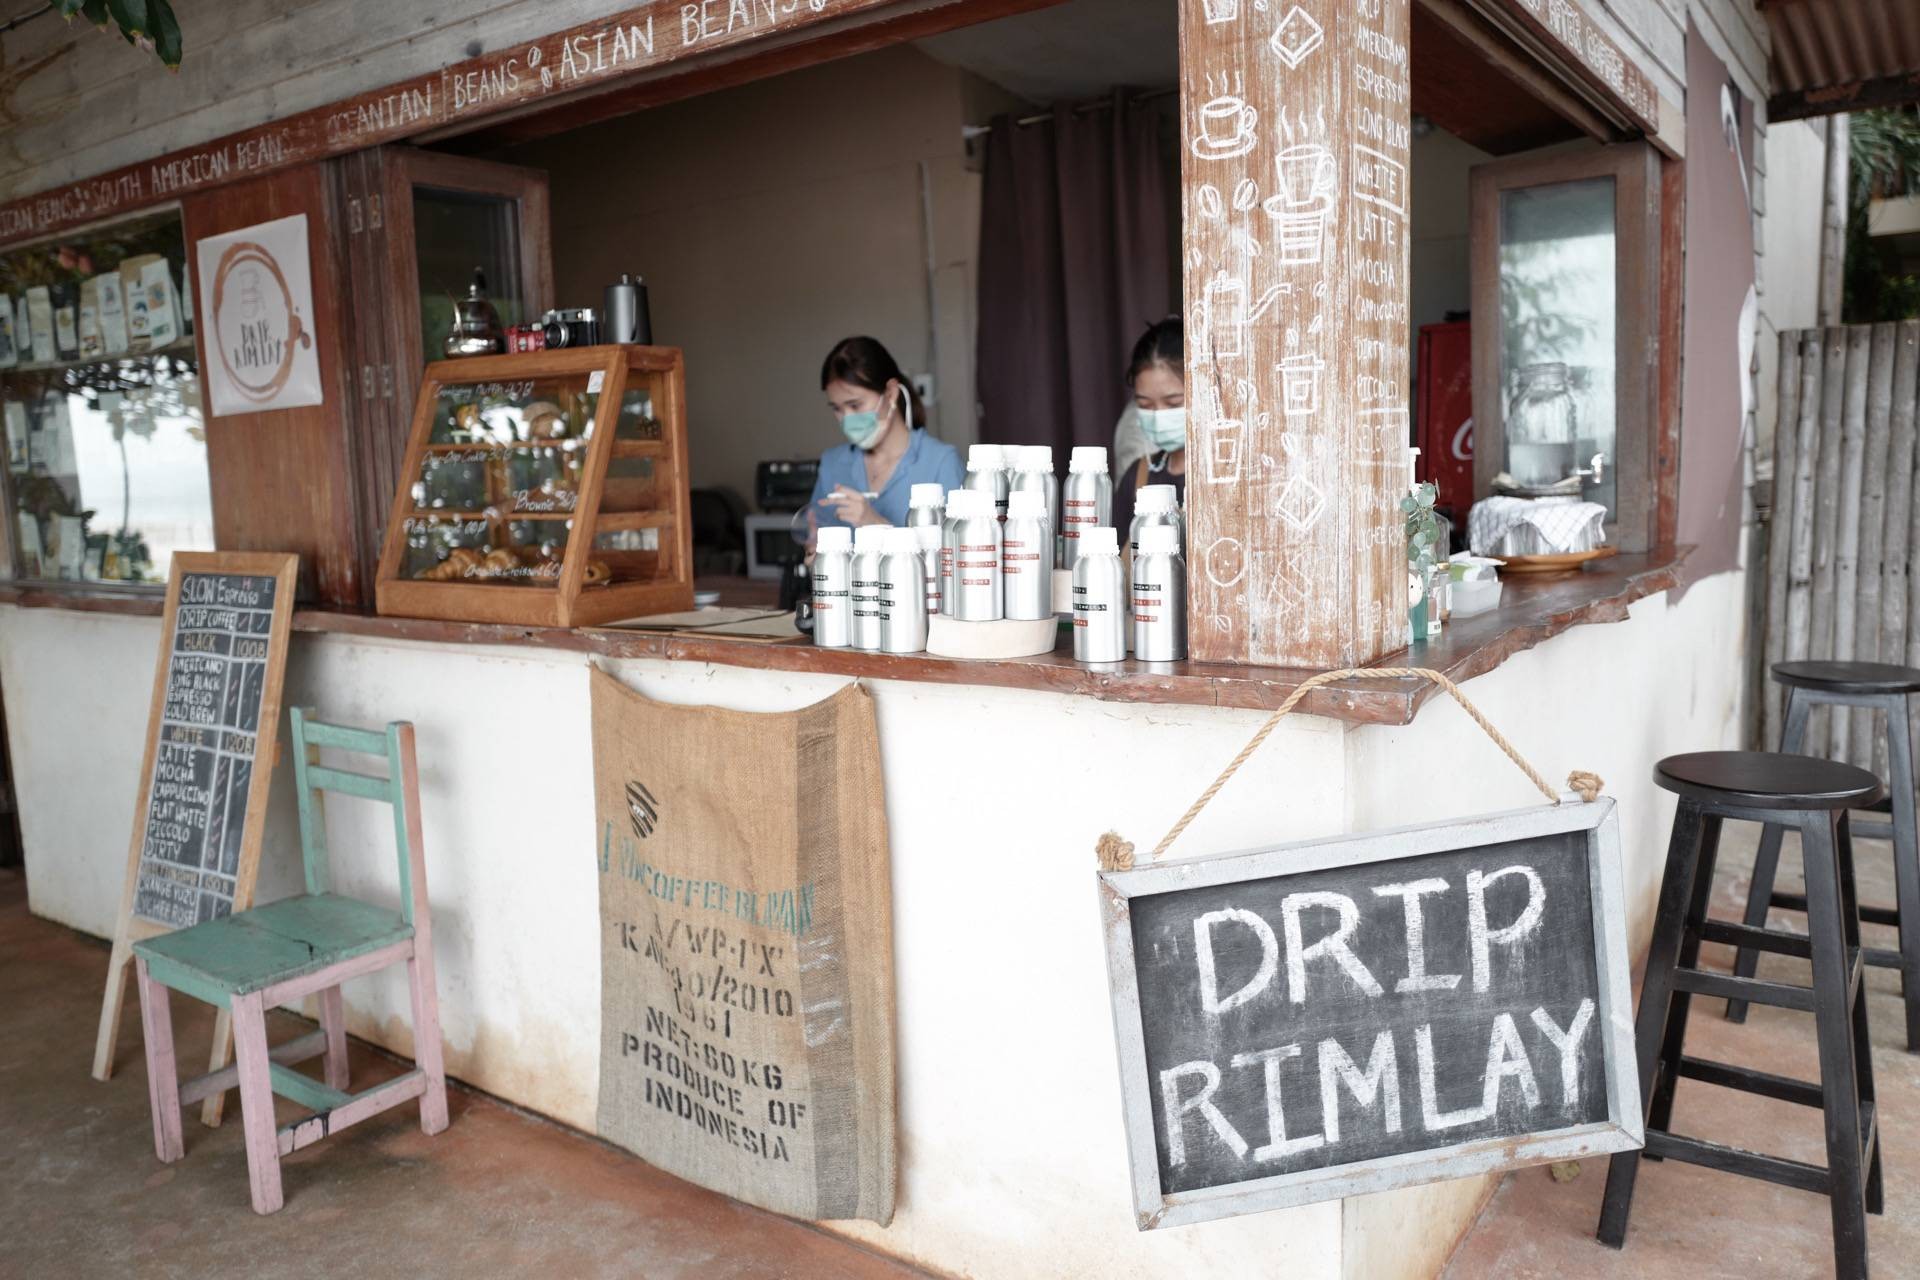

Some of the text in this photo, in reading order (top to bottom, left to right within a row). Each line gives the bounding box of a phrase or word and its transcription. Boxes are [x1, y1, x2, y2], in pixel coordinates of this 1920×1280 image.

[1356, 22, 1407, 66] AMERICANO
[1356, 63, 1403, 104] ESPRESSO
[92, 171, 141, 214] SOUTH
[151, 146, 230, 195] AMERICAN
[236, 127, 293, 171] BEANS
[454, 58, 519, 109] BEANS
[561, 15, 654, 80] ASIAN
[1356, 103, 1383, 141] LONG
[1356, 157, 1397, 196] WHITE
[1356, 208, 1396, 246] LATTE
[1357, 256, 1396, 288] MOCHA
[515, 489, 555, 511] Brownie
[180, 609, 208, 627] DRIP
[184, 632, 216, 653] BLACK
[173, 656, 223, 674] AMERICANO
[171, 673, 220, 691] LONG BLACK
[168, 687, 213, 706] ESPRESSO
[166, 704, 216, 722] COLD BREW
[160, 744, 195, 767] LATTE
[158, 762, 194, 782] MOCHA
[154, 782, 210, 805] CAPPUCCINO
[152, 800, 207, 829] FLAT WHITE
[150, 819, 191, 843] PICCOLO
[145, 836, 183, 859] DIRTY
[1193, 864, 1547, 1014] DRIP
[622, 1031, 806, 1130] PRODUCE OF
[1159, 997, 1596, 1168] RIMLAY
[645, 1077, 790, 1162] INDONESIA
